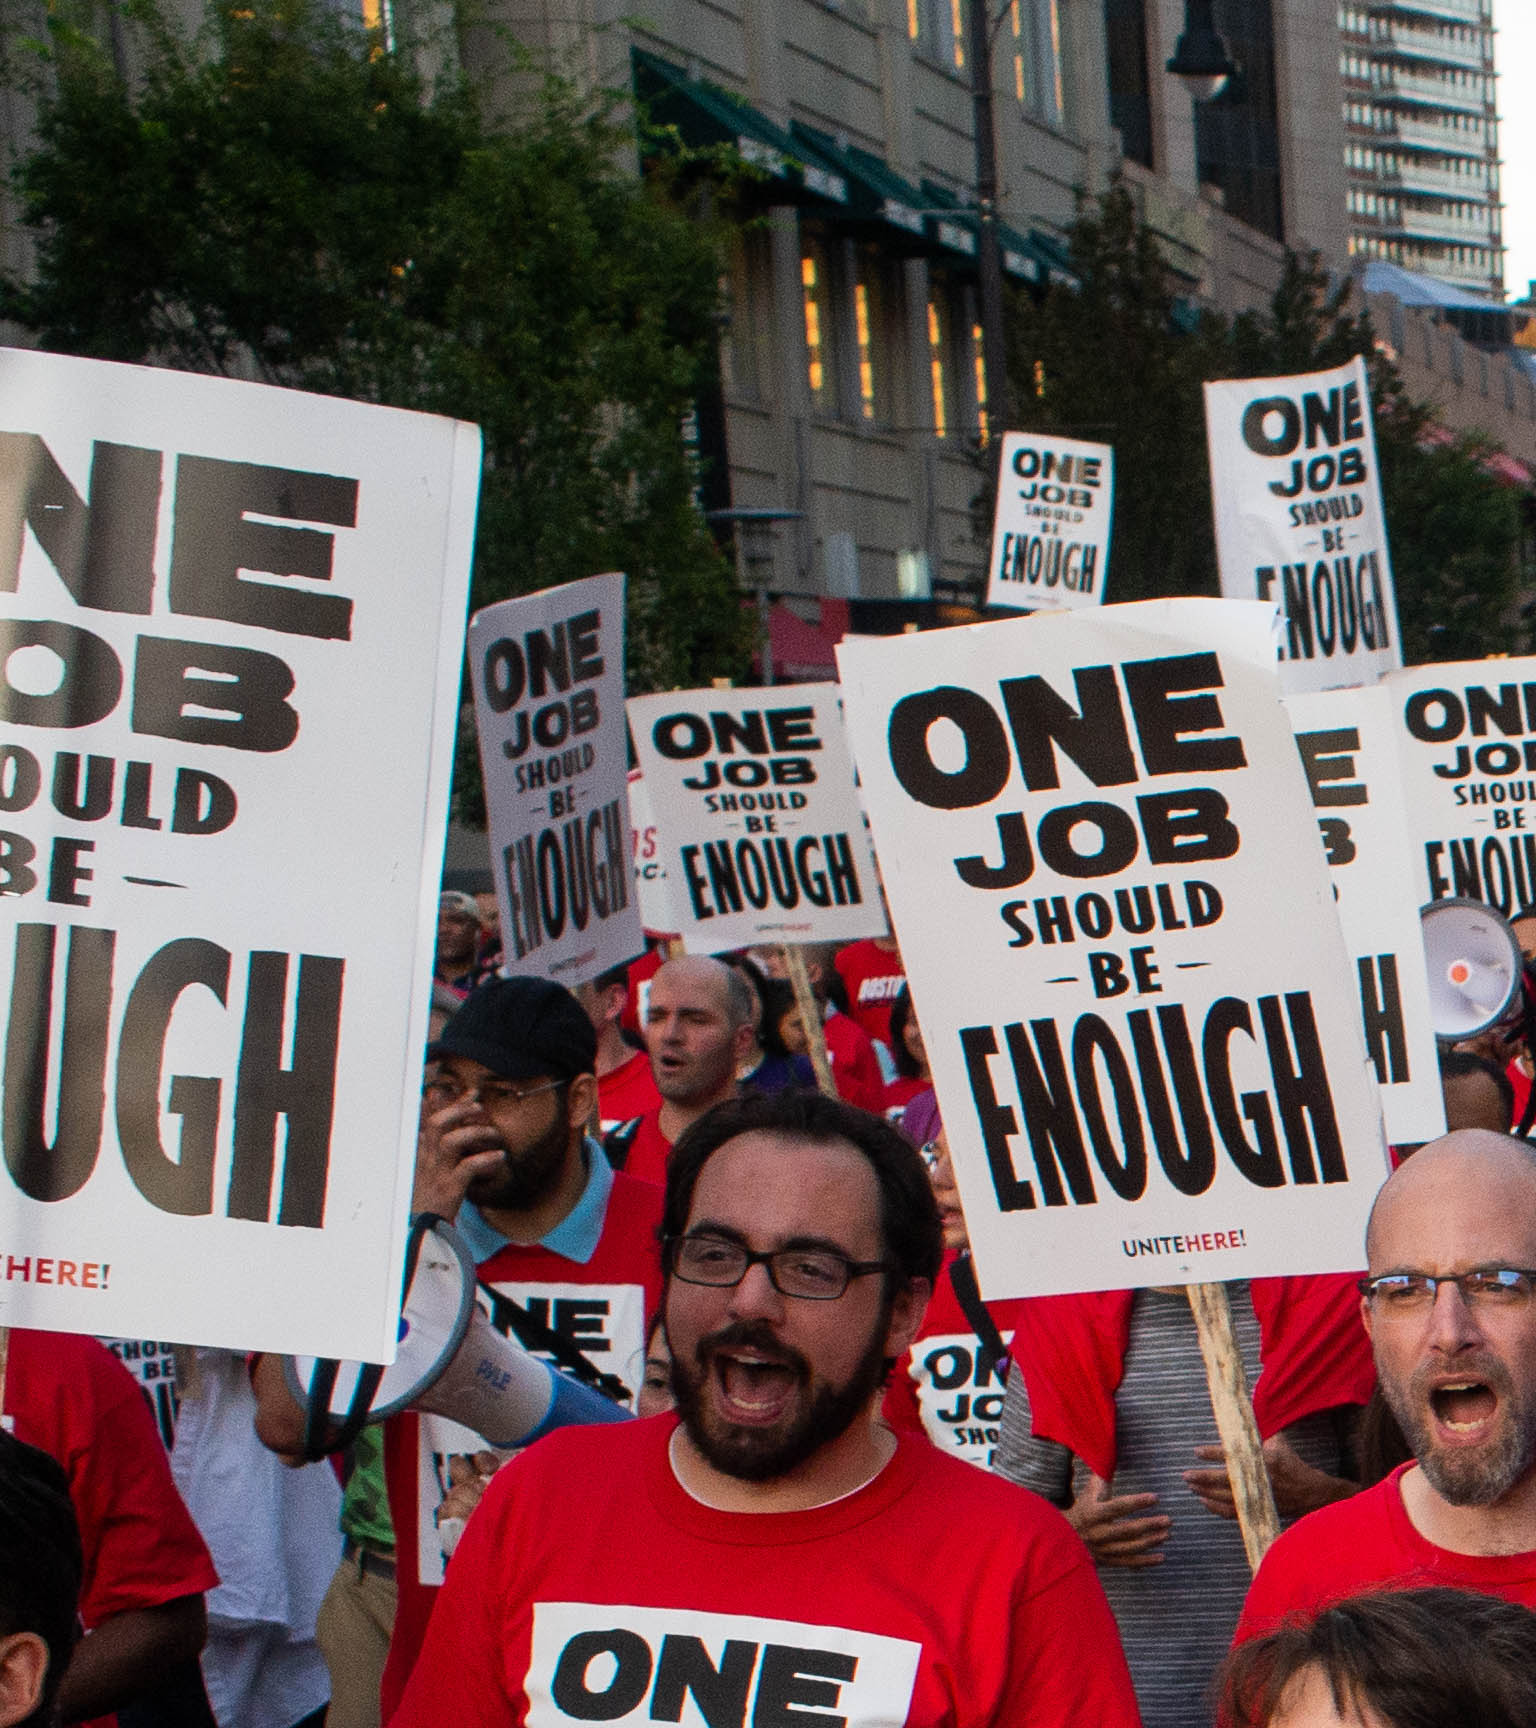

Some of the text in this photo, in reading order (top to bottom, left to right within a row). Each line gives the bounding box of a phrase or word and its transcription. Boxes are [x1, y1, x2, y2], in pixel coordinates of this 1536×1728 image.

[1242, 381, 1364, 457] ONE
[1012, 449, 1102, 486] ONE
[1268, 448, 1367, 498] JOB
[1019, 483, 1093, 508] JOB
[1289, 493, 1364, 528] SHOULD
[0, 432, 360, 641] NE
[1322, 527, 1345, 552] BE
[1000, 533, 1098, 594] ENOUGH
[484, 608, 604, 713] ONE
[503, 688, 600, 760] JOB
[652, 706, 823, 760] ONE
[888, 652, 1249, 811] ONE
[0, 743, 238, 835] OULD
[515, 743, 595, 794] SHOULD
[682, 756, 818, 790] JOB
[549, 788, 575, 819] BE
[705, 792, 808, 812] SHOULD
[745, 815, 779, 834] BE
[1494, 808, 1526, 830] BE
[953, 788, 1241, 890] JOB
[504, 800, 629, 961] ENOUGH
[680, 833, 863, 921] ENOUGH
[1000, 881, 1223, 948] SHOULD
[1088, 947, 1164, 999] BE
[0, 922, 346, 1230] UGH
[959, 991, 1350, 1213] ENOUGH
[1123, 1229, 1247, 1258] UNITEHERE!
[0, 1253, 111, 1290] HERE!
[490, 1297, 612, 1352] NE
[936, 1393, 1004, 1423] JO
[953, 1427, 1000, 1446] SHO
